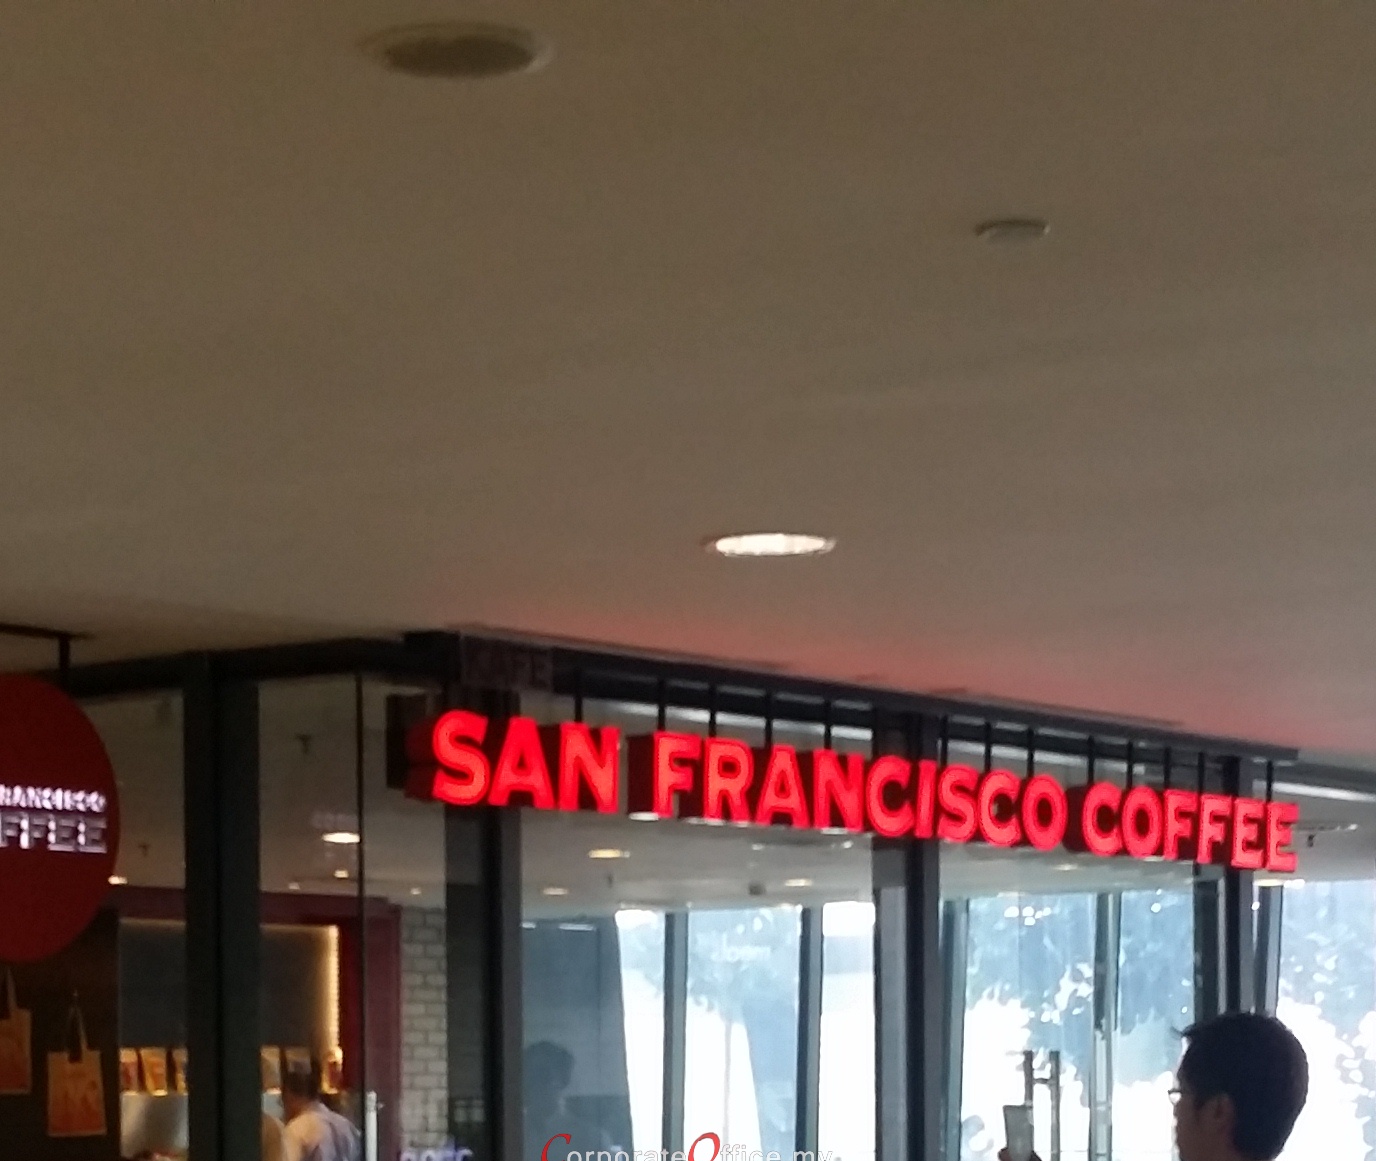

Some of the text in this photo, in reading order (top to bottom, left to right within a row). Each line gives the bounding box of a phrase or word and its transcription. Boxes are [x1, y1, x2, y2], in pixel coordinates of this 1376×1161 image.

[432, 709, 1300, 873] SAN FRANCISCO COFFEE
